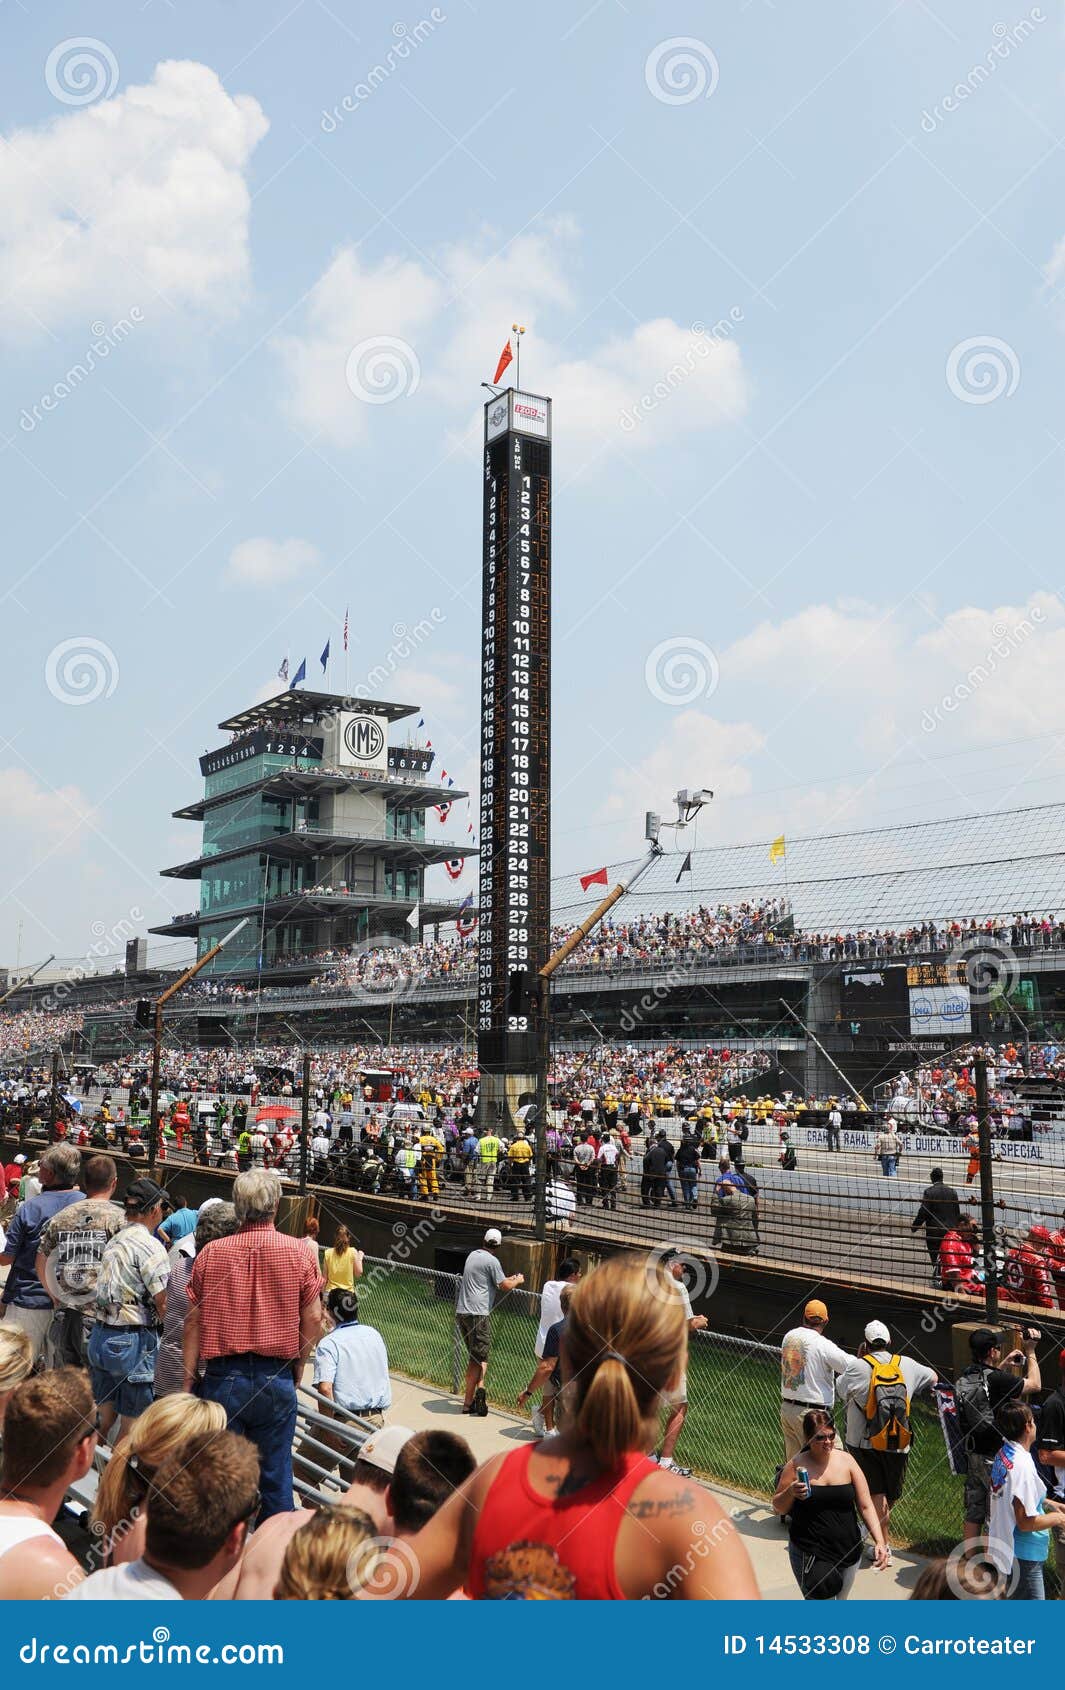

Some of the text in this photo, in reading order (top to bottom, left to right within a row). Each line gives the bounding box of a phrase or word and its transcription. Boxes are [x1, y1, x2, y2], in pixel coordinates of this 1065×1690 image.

[515, 404, 538, 417] IZOD
[491, 481, 496, 492] 1
[523, 476, 530, 488] 1
[489, 497, 496, 509] 2
[521, 491, 530, 504] 2
[489, 513, 496, 525] 3
[521, 507, 530, 520] 3
[489, 529, 496, 541] 4
[520, 524, 529, 536] 4
[489, 545, 496, 557] 5
[521, 540, 530, 552] 5
[489, 562, 496, 574] 6
[521, 556, 530, 568] 6
[489, 577, 496, 590] 7
[521, 572, 530, 585] 7
[489, 593, 495, 606] 8
[521, 589, 530, 601] 8
[489, 610, 495, 622] 9
[521, 605, 530, 617] 9
[484, 626, 495, 640] 10
[512, 620, 530, 634] 10
[485, 642, 495, 656] 11
[514, 637, 530, 651] 11
[484, 659, 495, 672] 12
[512, 654, 530, 668] 12
[484, 675, 495, 689] 13
[512, 670, 529, 684] 13
[483, 692, 494, 706] 14
[512, 687, 529, 701] 14
[483, 708, 494, 722] 15
[512, 704, 529, 717] 15
[483, 725, 494, 739] 16
[512, 721, 529, 734] 16
[351, 722, 379, 754] IMS
[512, 738, 529, 751] 17
[266, 743, 307, 756] 1 2 3 4
[483, 742, 494, 755] 17
[389, 758, 394, 767] 5
[400, 759, 405, 767] 6
[411, 760, 417, 769] 7
[422, 762, 427, 770] 8
[482, 759, 494, 772] 18
[512, 755, 529, 768] 18
[482, 775, 494, 789] 19
[511, 772, 529, 785] 19
[482, 792, 494, 807] 20
[510, 788, 529, 802] 20
[481, 809, 493, 823] 21
[509, 806, 529, 819] 21
[481, 826, 493, 840] 22
[509, 823, 529, 836] 22
[481, 843, 493, 857] 23
[509, 840, 528, 854] 23
[480, 860, 493, 874] 24
[508, 858, 528, 871] 24
[480, 878, 493, 892] 25
[509, 875, 528, 888] 25
[480, 895, 492, 908] 26
[509, 893, 528, 906] 26
[480, 912, 492, 924] 27
[509, 910, 528, 923] 27
[480, 930, 492, 943] 28
[509, 928, 528, 942] 28
[480, 947, 492, 960] 29
[508, 946, 528, 959] 29
[480, 965, 492, 978] 30
[480, 982, 492, 996] 31
[480, 1000, 492, 1012] 32
[480, 1018, 492, 1030] 33
[508, 1017, 528, 1030] 33
[843, 1132, 872, 1147] RAHAL
[916, 1138, 941, 1152] QUICK
[1001, 1143, 1044, 1160] SPECIAL
